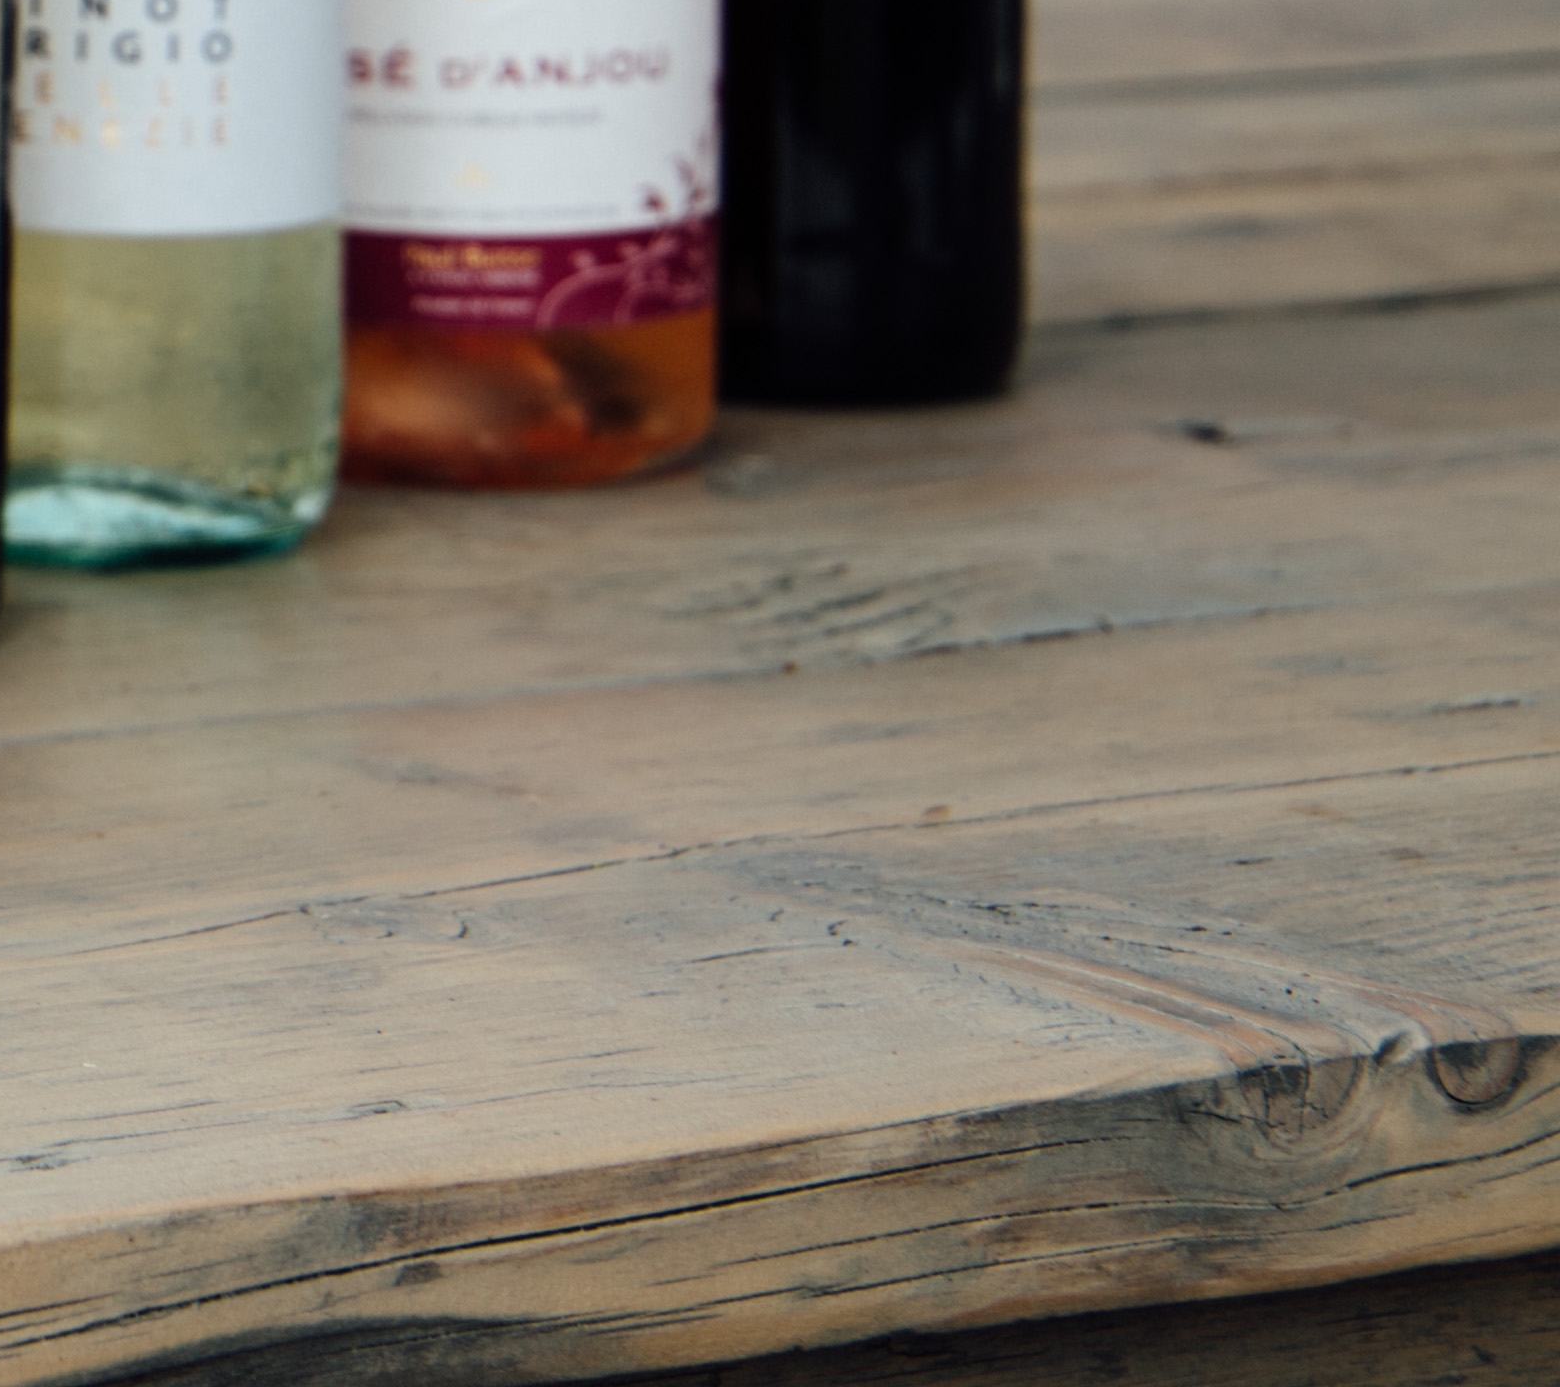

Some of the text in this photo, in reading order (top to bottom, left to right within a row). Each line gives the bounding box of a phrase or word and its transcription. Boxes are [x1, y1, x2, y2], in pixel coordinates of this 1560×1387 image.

[24, 28, 234, 65] RIGIO
[34, 71, 229, 108] ELLE
[12, 108, 229, 150] ENEZIE
